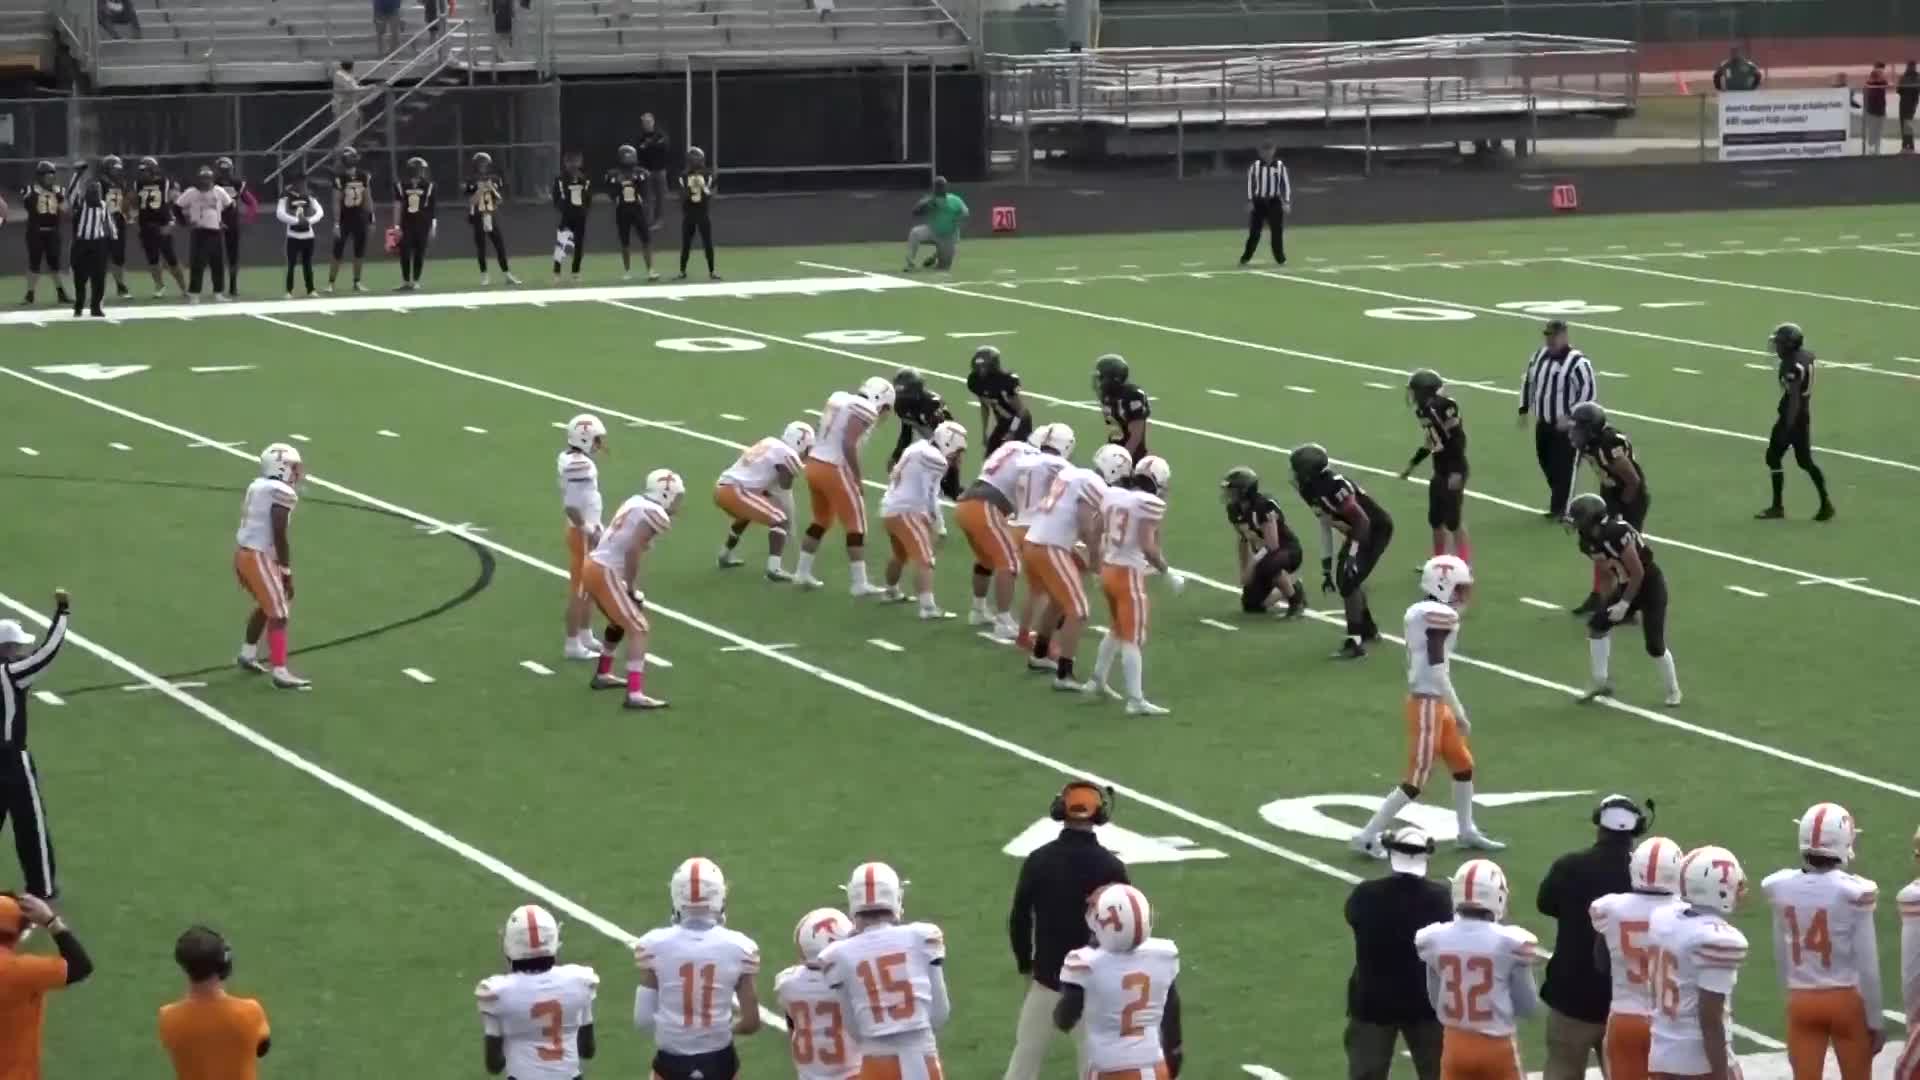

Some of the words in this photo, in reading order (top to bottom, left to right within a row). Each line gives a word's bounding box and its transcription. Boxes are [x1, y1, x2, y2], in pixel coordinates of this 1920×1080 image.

[994, 208, 1015, 230] 20
[1712, 859, 1734, 884] T
[1619, 921, 1649, 984] 5
[1783, 905, 1832, 970] 14
[679, 962, 716, 1027] 11
[855, 952, 914, 1024] 15
[1119, 971, 1151, 1038] 2
[1439, 953, 1494, 1020] 32
[530, 1000, 563, 1061] 3
[790, 1001, 846, 1065] 83
